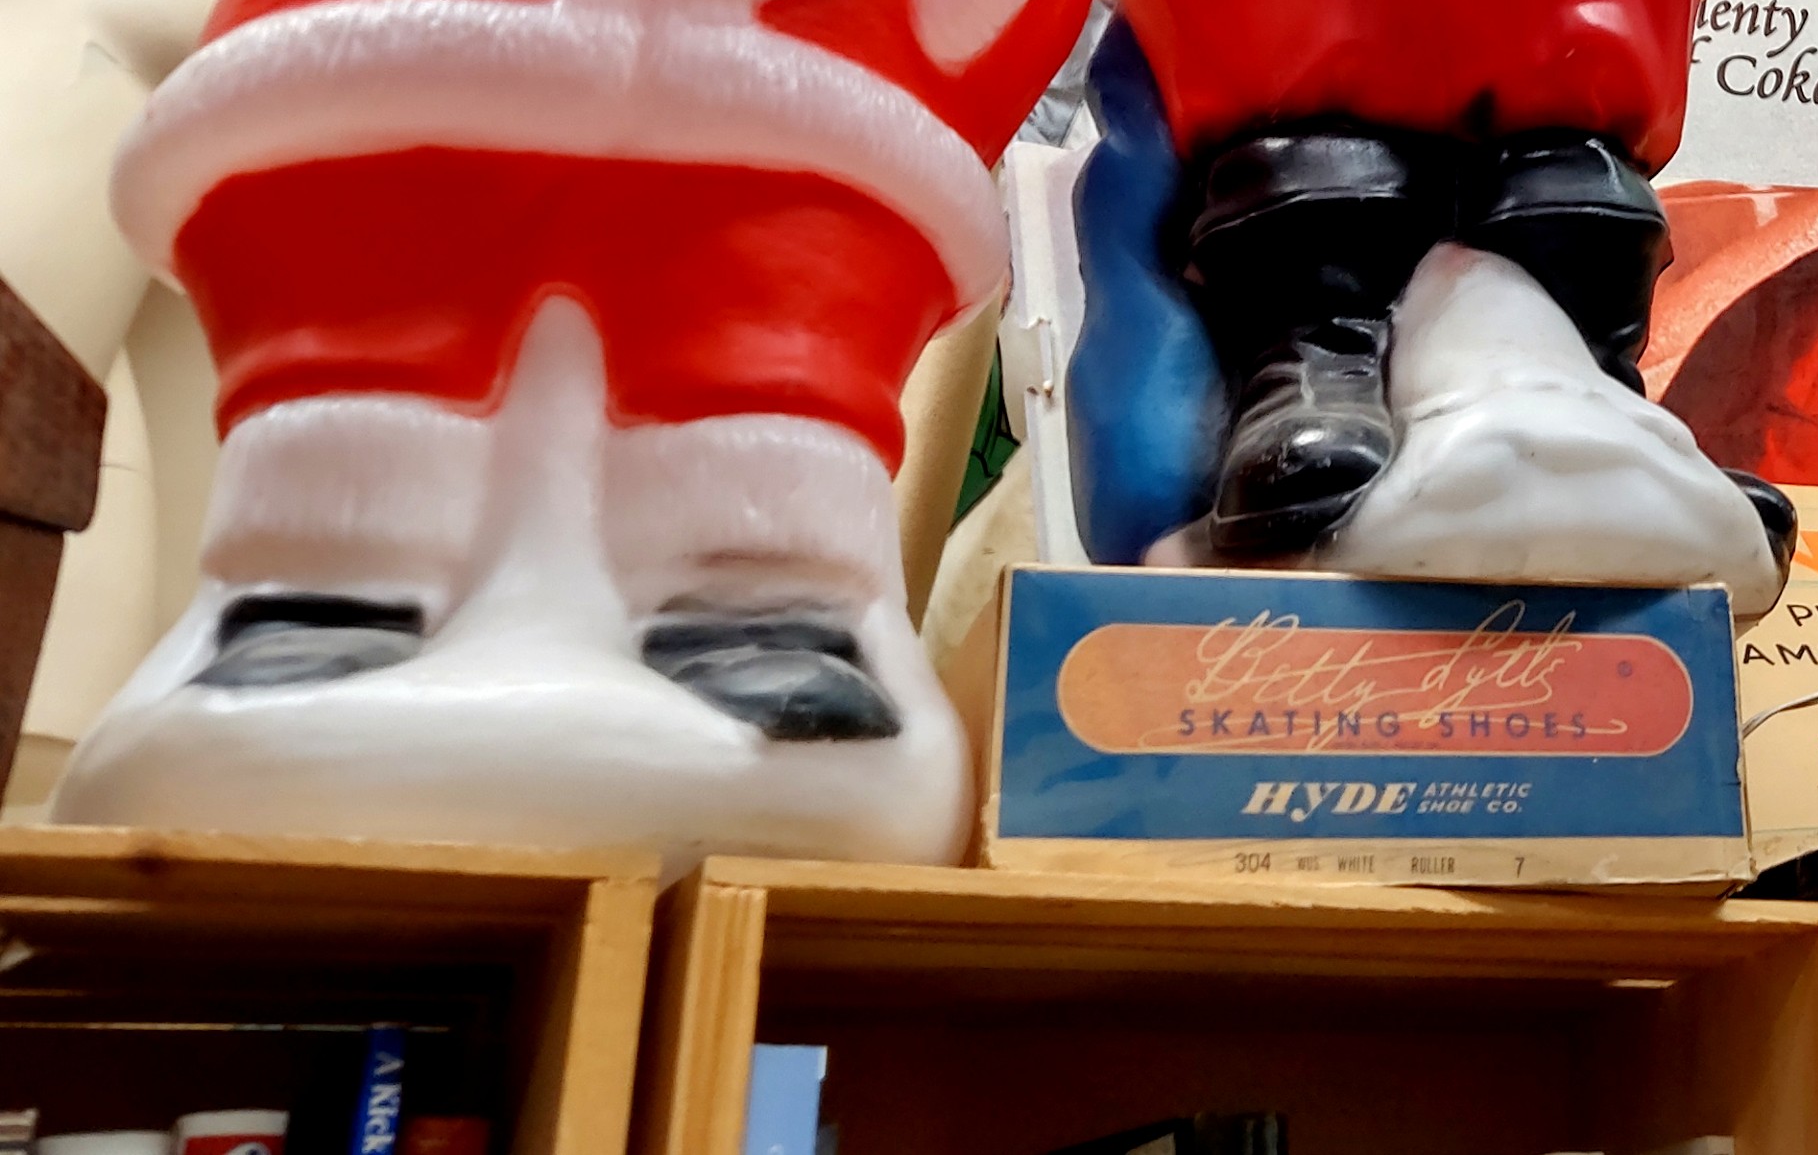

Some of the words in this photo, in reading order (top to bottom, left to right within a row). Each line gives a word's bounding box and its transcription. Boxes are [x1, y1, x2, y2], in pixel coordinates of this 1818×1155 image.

[1179, 709, 1402, 740] SKATING
[1439, 711, 1588, 741] SHOES
[1240, 781, 1418, 823] HYDE
[1423, 782, 1533, 798] ATHLETIC
[1416, 799, 1474, 814] SHOE
[1486, 799, 1524, 814] CO.
[1233, 852, 1273, 874] 304
[1337, 854, 1376, 875] WHITE
[1514, 857, 1526, 879] 7
